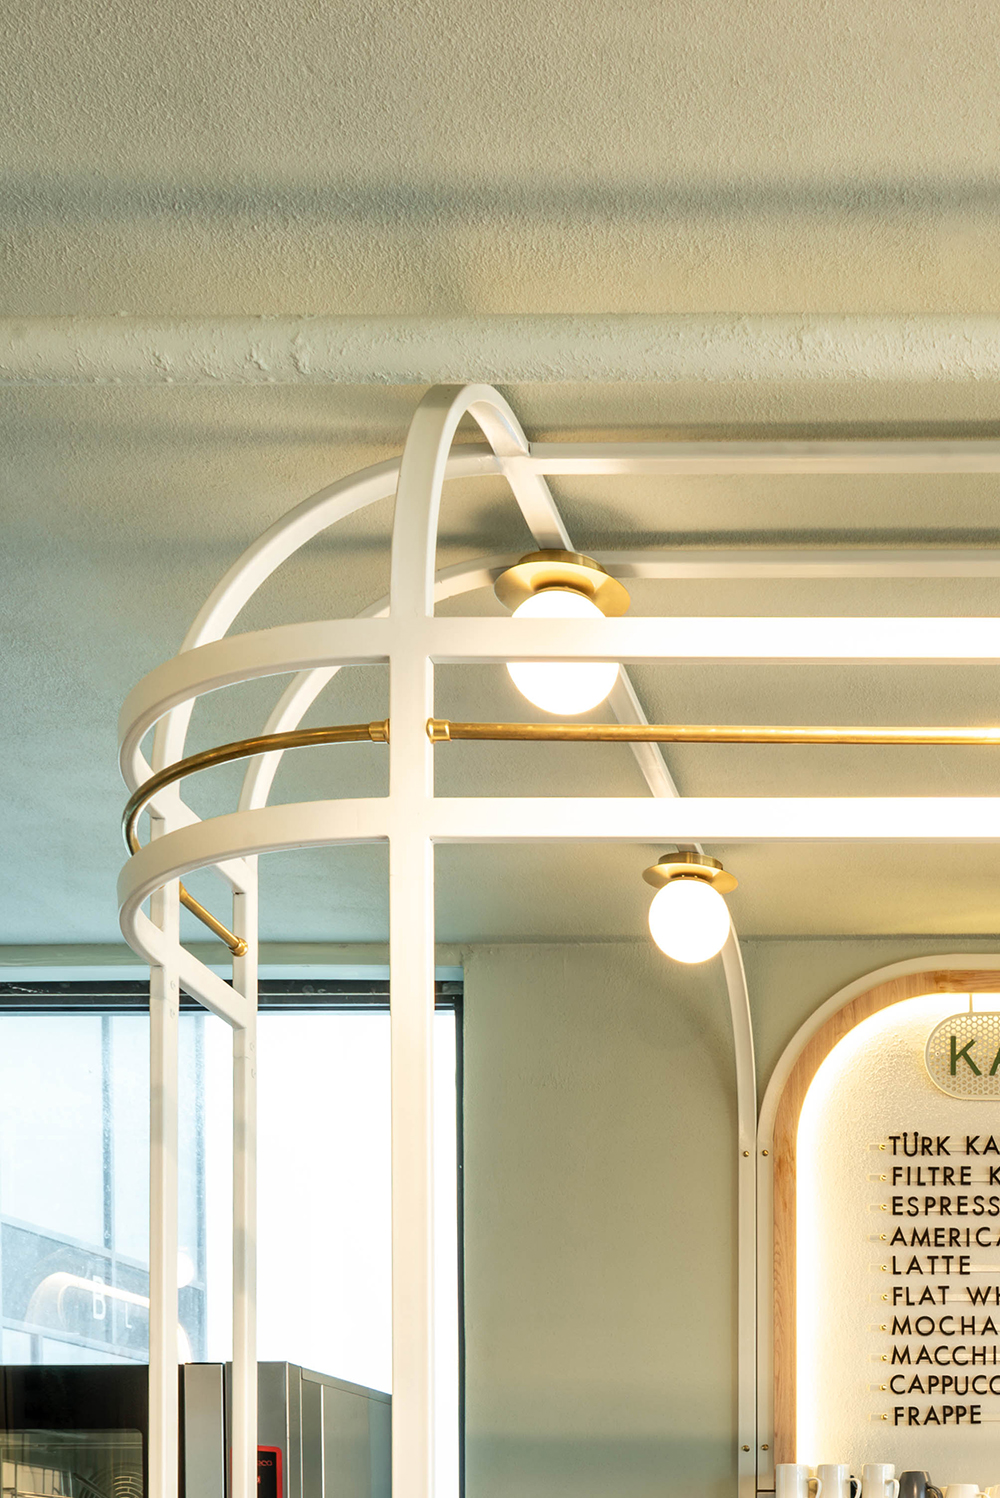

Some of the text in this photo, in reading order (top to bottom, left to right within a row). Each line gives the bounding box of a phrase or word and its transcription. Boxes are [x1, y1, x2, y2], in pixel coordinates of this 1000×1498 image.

[888, 1131, 951, 1158] TÜRK
[892, 1165, 972, 1187] FILTRE
[892, 1255, 971, 1276] LATTE
[892, 1285, 950, 1307] FLAT
[891, 1315, 999, 1337] MOCHA
[894, 1404, 982, 1426] FRAPPE
